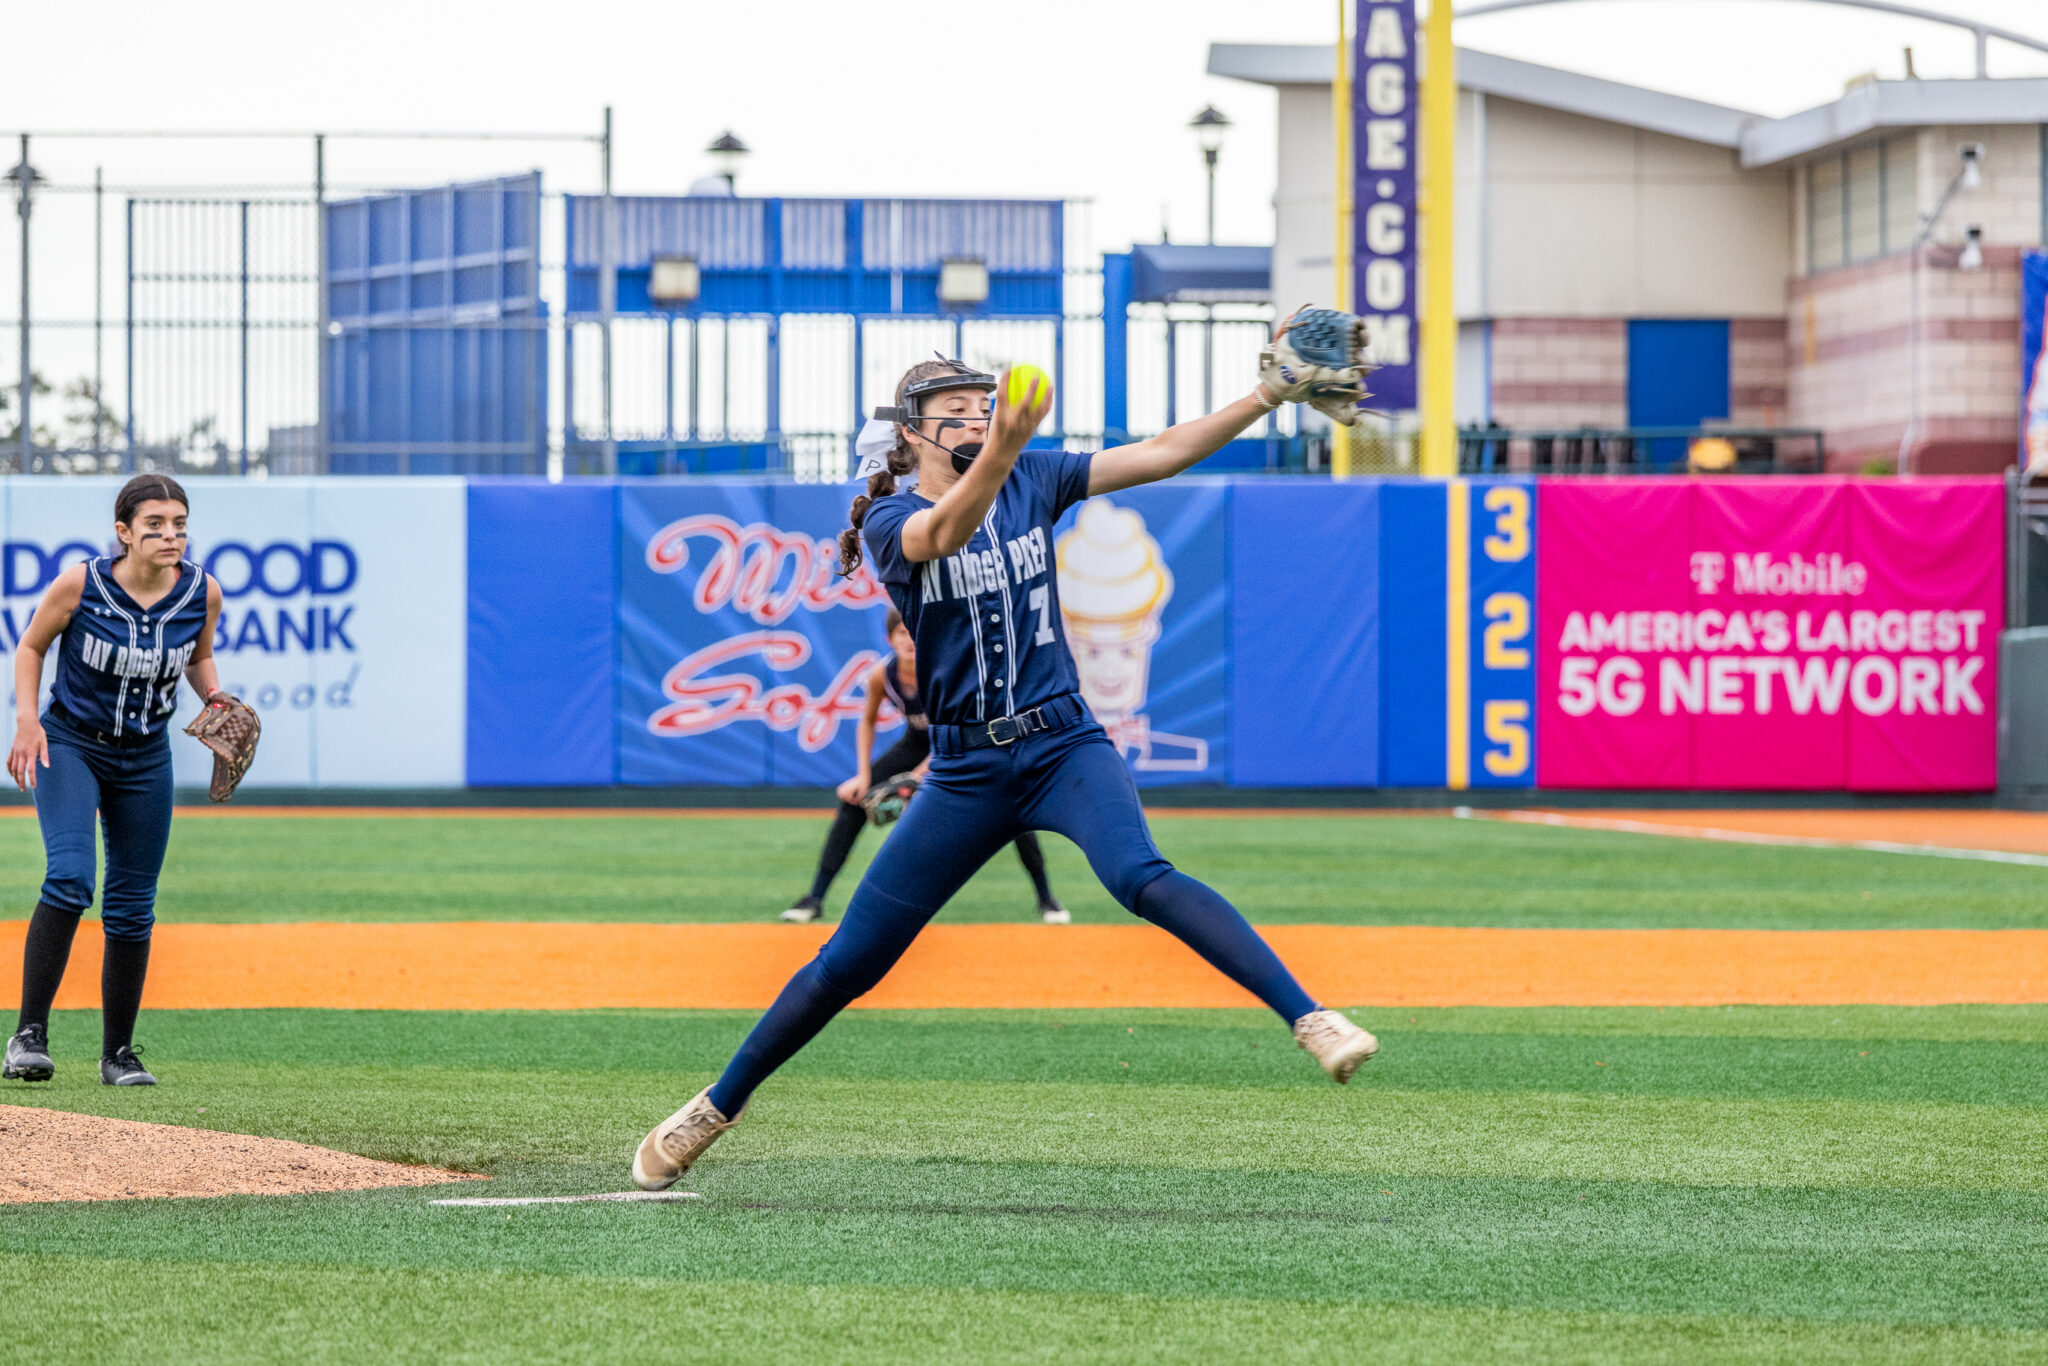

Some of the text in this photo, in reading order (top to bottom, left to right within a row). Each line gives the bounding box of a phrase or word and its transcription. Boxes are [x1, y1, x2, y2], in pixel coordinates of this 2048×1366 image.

[1364, 0, 1410, 366] AGE.COM
[646, 513, 889, 626] Mis
[921, 526, 1047, 604] AY RIDGE PREP
[1733, 552, 1867, 597] Mobile
[1029, 583, 1056, 647] 7
[1558, 609, 1986, 653] AMERICA'S LARGEST
[82, 632, 113, 673] BAY
[113, 647, 162, 679] RIDGE
[1558, 655, 1986, 717] 5G NETWORK
[647, 631, 905, 753] Sof
